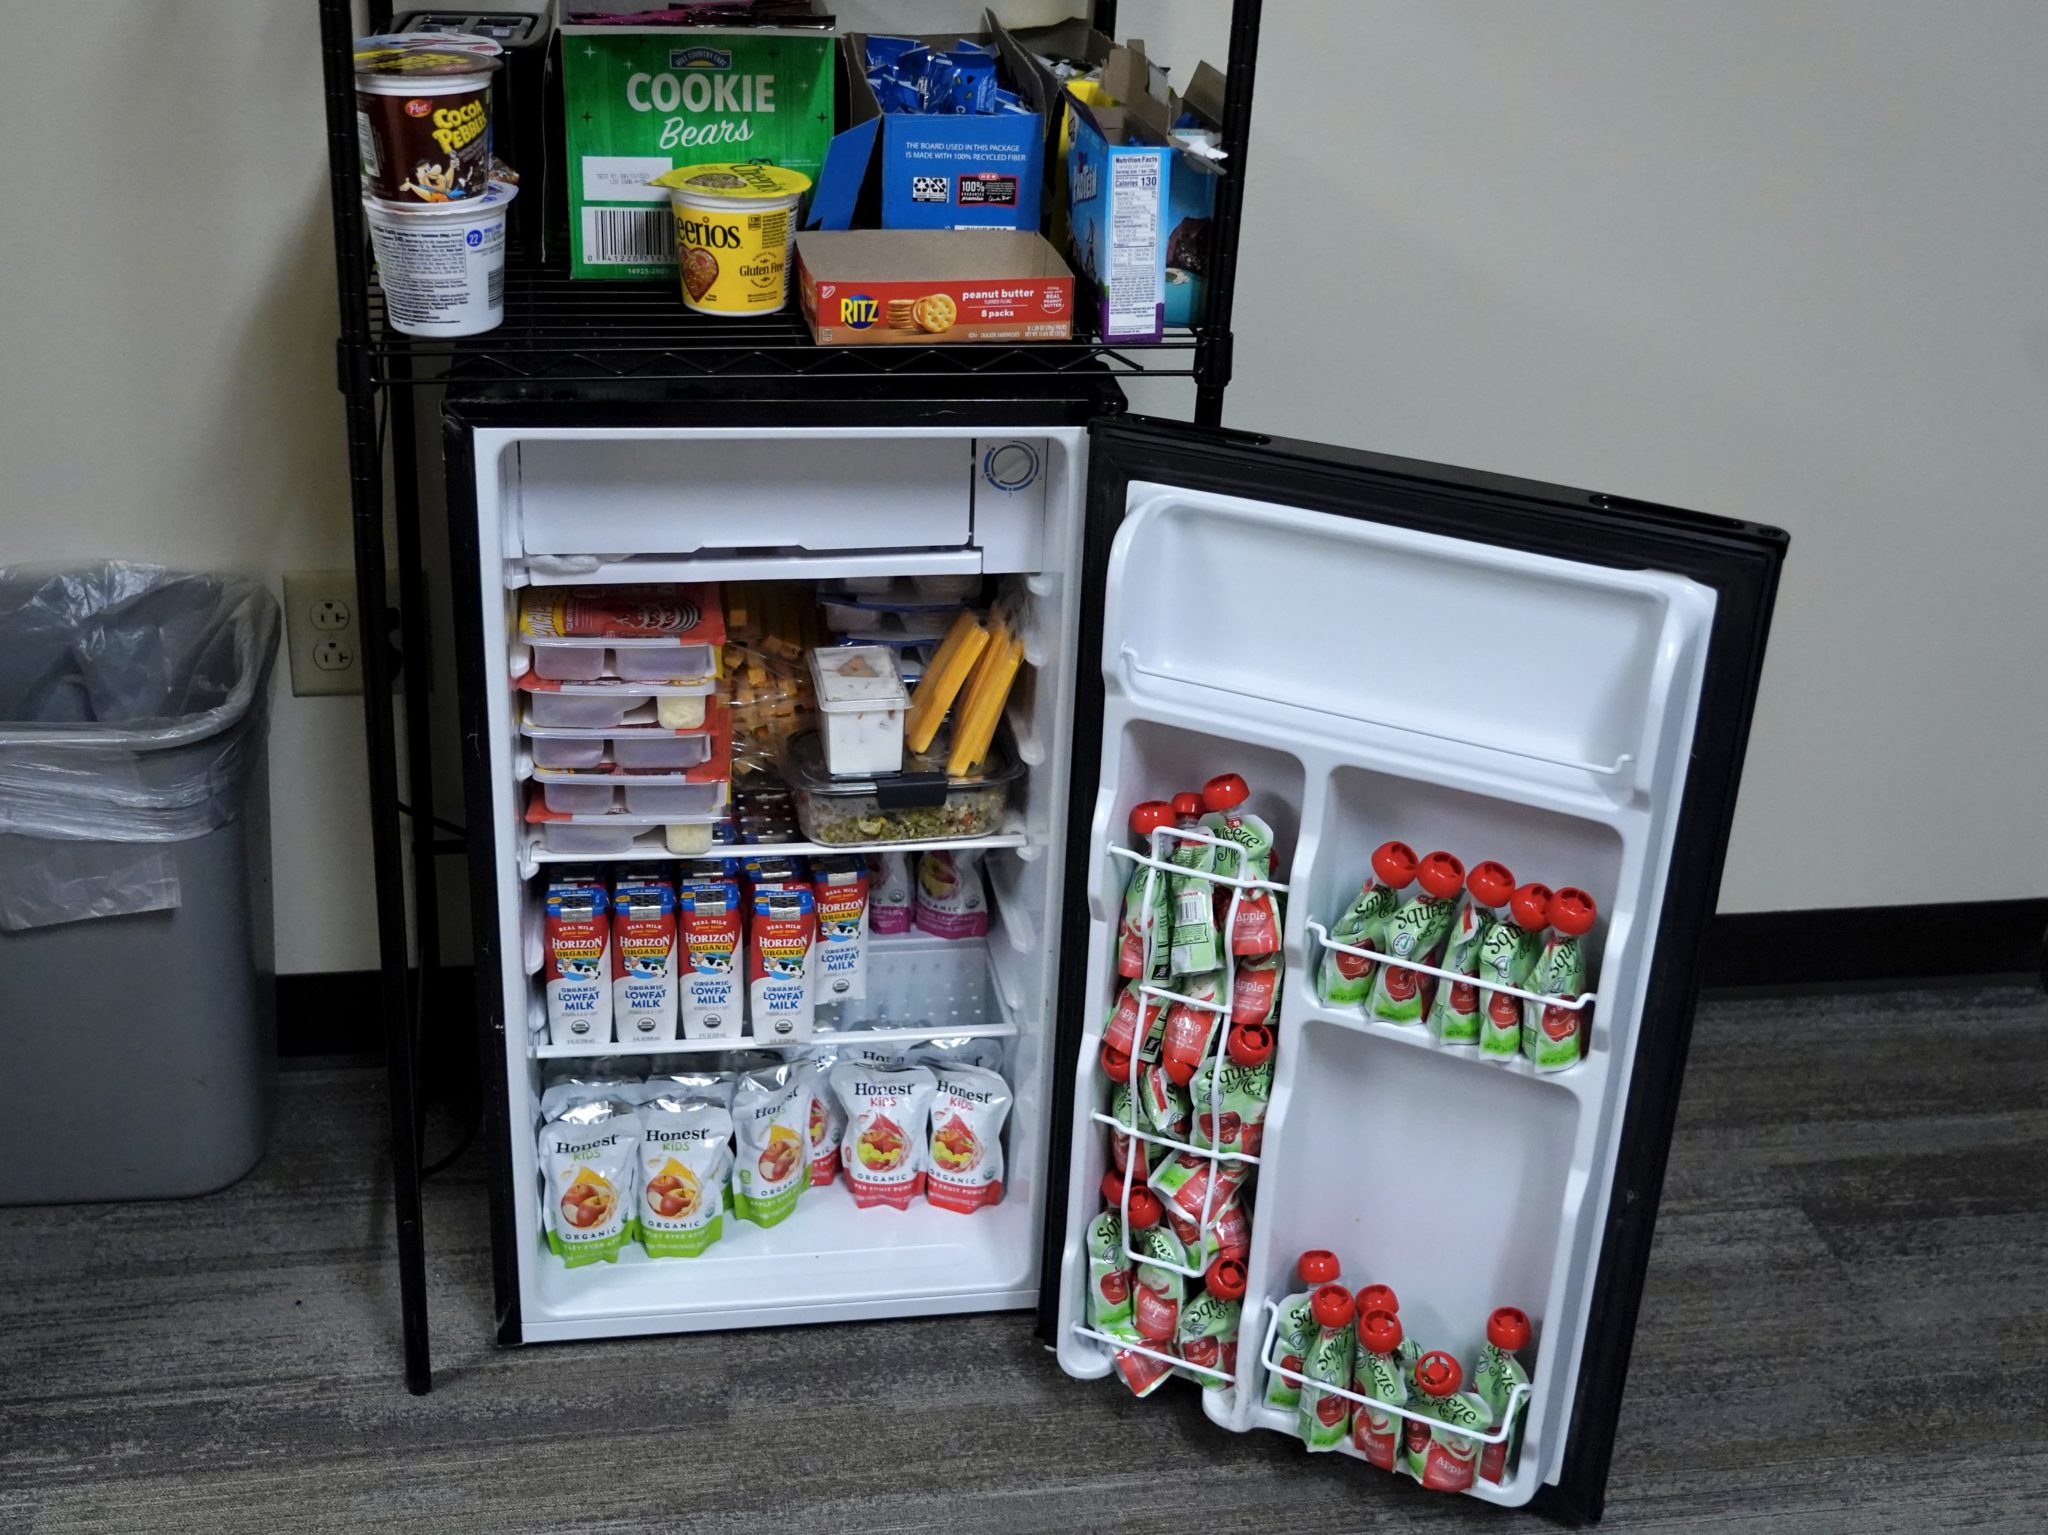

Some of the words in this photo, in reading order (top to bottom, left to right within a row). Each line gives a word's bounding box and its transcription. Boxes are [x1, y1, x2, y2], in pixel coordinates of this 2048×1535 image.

[627, 72, 776, 112] COOKIE
[410, 102, 428, 114] Post
[433, 100, 483, 128] COCOA
[432, 113, 487, 155] PEBBLES
[659, 116, 754, 150] Bears
[921, 142, 945, 150] BOARD
[945, 143, 964, 151] USED
[989, 144, 1020, 152] PACKAGE
[913, 151, 933, 159] MADE
[972, 153, 1007, 161] RECYCLED
[962, 181, 985, 192] 100%
[1141, 176, 1157, 187] 130
[469, 234, 479, 245] 22
[739, 264, 770, 277] Gluten
[770, 262, 784, 274] Free
[962, 289, 1000, 301] peanut
[1001, 289, 1035, 298] butter
[840, 298, 879, 324] RITZ
[988, 309, 1014, 319] packs
[817, 898, 864, 913] HORIZON
[820, 912, 861, 920] ORGANIC
[1236, 911, 1267, 923] Apple
[552, 936, 602, 949] HORIZON
[620, 935, 670, 947] HORIZON
[685, 931, 735, 944] HORIZON
[759, 934, 807, 948] HORIZON
[689, 943, 731, 951] ORGANIC
[764, 948, 804, 956] ORGANIC
[825, 946, 858, 954] ORGANIC
[556, 949, 599, 957] ORGANIC
[822, 951, 860, 962] LOWFAT
[828, 962, 855, 971] MILK
[625, 989, 667, 1000] LOWFAT
[691, 985, 732, 994] LOWFAT
[558, 990, 600, 1001] LOWFAT
[697, 995, 726, 1004] MILK
[763, 991, 804, 1001] LOWFAT
[564, 1001, 594, 1010] MILK
[631, 999, 660, 1008] MILK
[769, 1000, 798, 1010] MILK
[855, 1082, 915, 1096] Honest
[1226, 1076, 1262, 1096] Me!
[936, 1080, 993, 1105] Honest
[645, 1128, 710, 1142] Honest
[556, 1134, 620, 1154] Honest
[662, 1142, 690, 1152] KIDS
[857, 1172, 907, 1182] ORGANIC
[929, 1168, 977, 1185] ORGANIC
[648, 1220, 700, 1229] ORGANIC
[565, 1226, 617, 1240] ORGANIC
[1142, 1296, 1171, 1315] Apple
